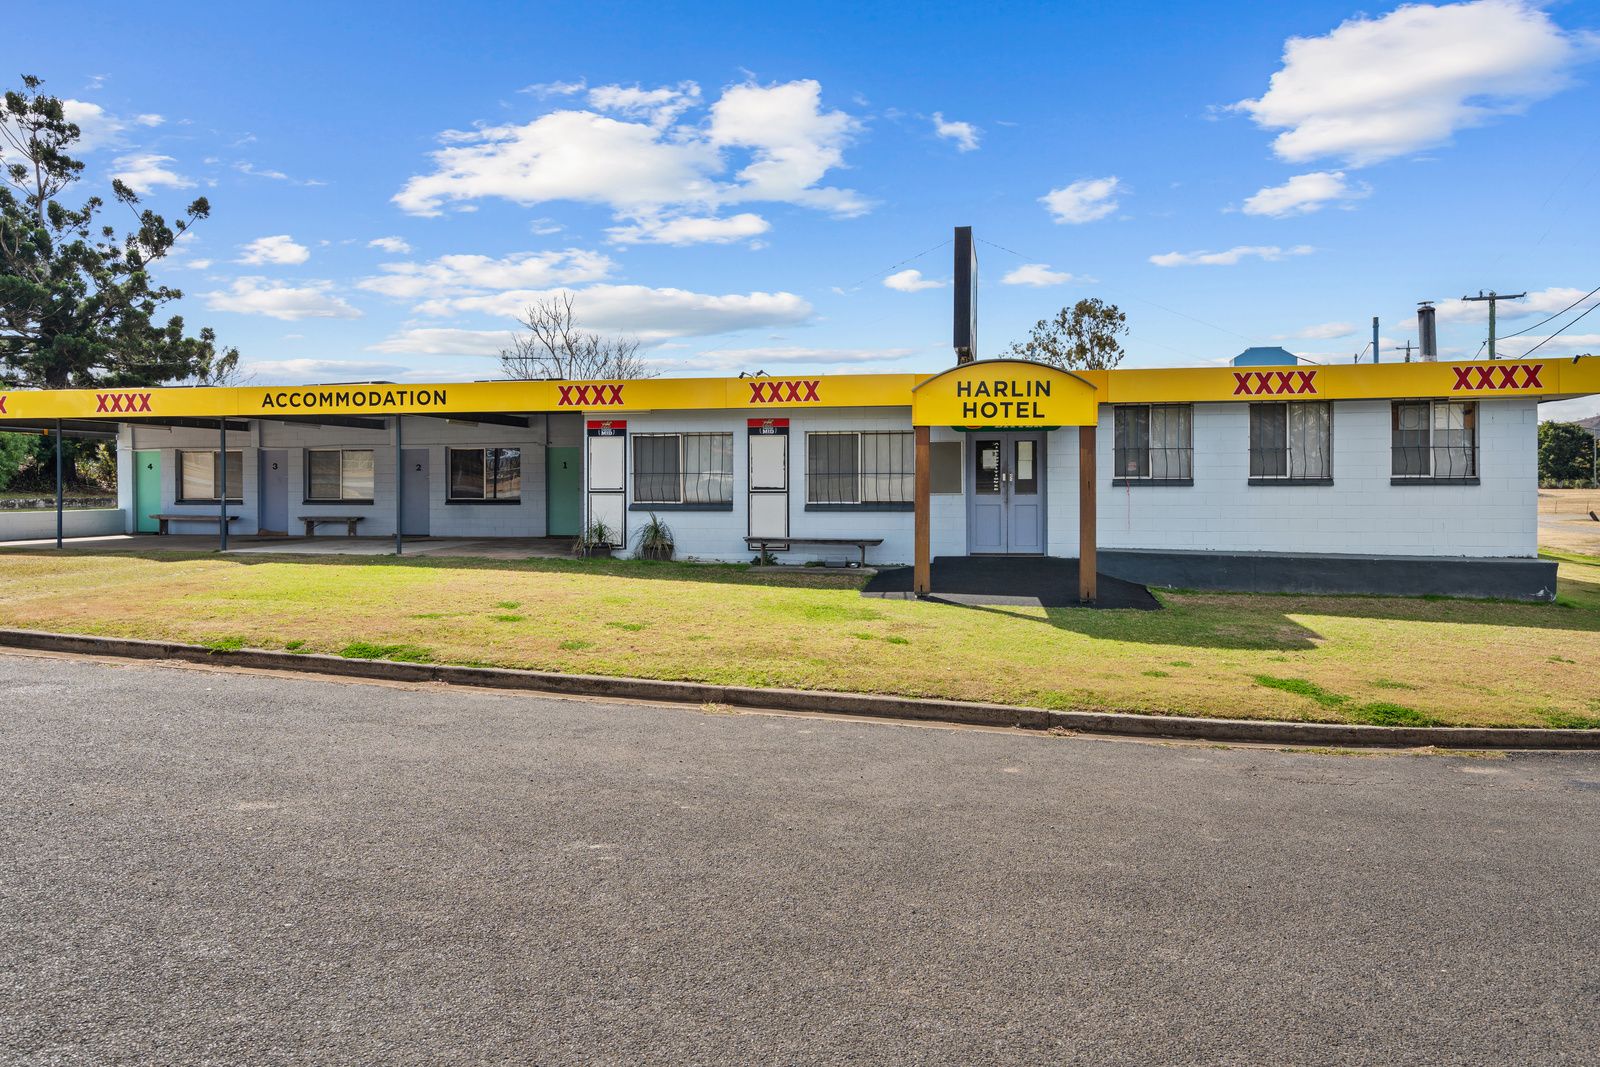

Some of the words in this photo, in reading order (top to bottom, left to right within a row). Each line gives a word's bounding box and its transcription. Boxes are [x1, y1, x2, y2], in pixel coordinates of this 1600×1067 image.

[1233, 370, 1318, 395] XXXX
[1452, 364, 1544, 391] XXXX
[262, 389, 448, 408] ACCOMMODATION
[557, 384, 625, 406] XXXX
[749, 380, 821, 404] XXXX
[957, 380, 1051, 397] HARLIN
[96, 393, 152, 413] XXXX
[963, 402, 1045, 418] HOTEL
